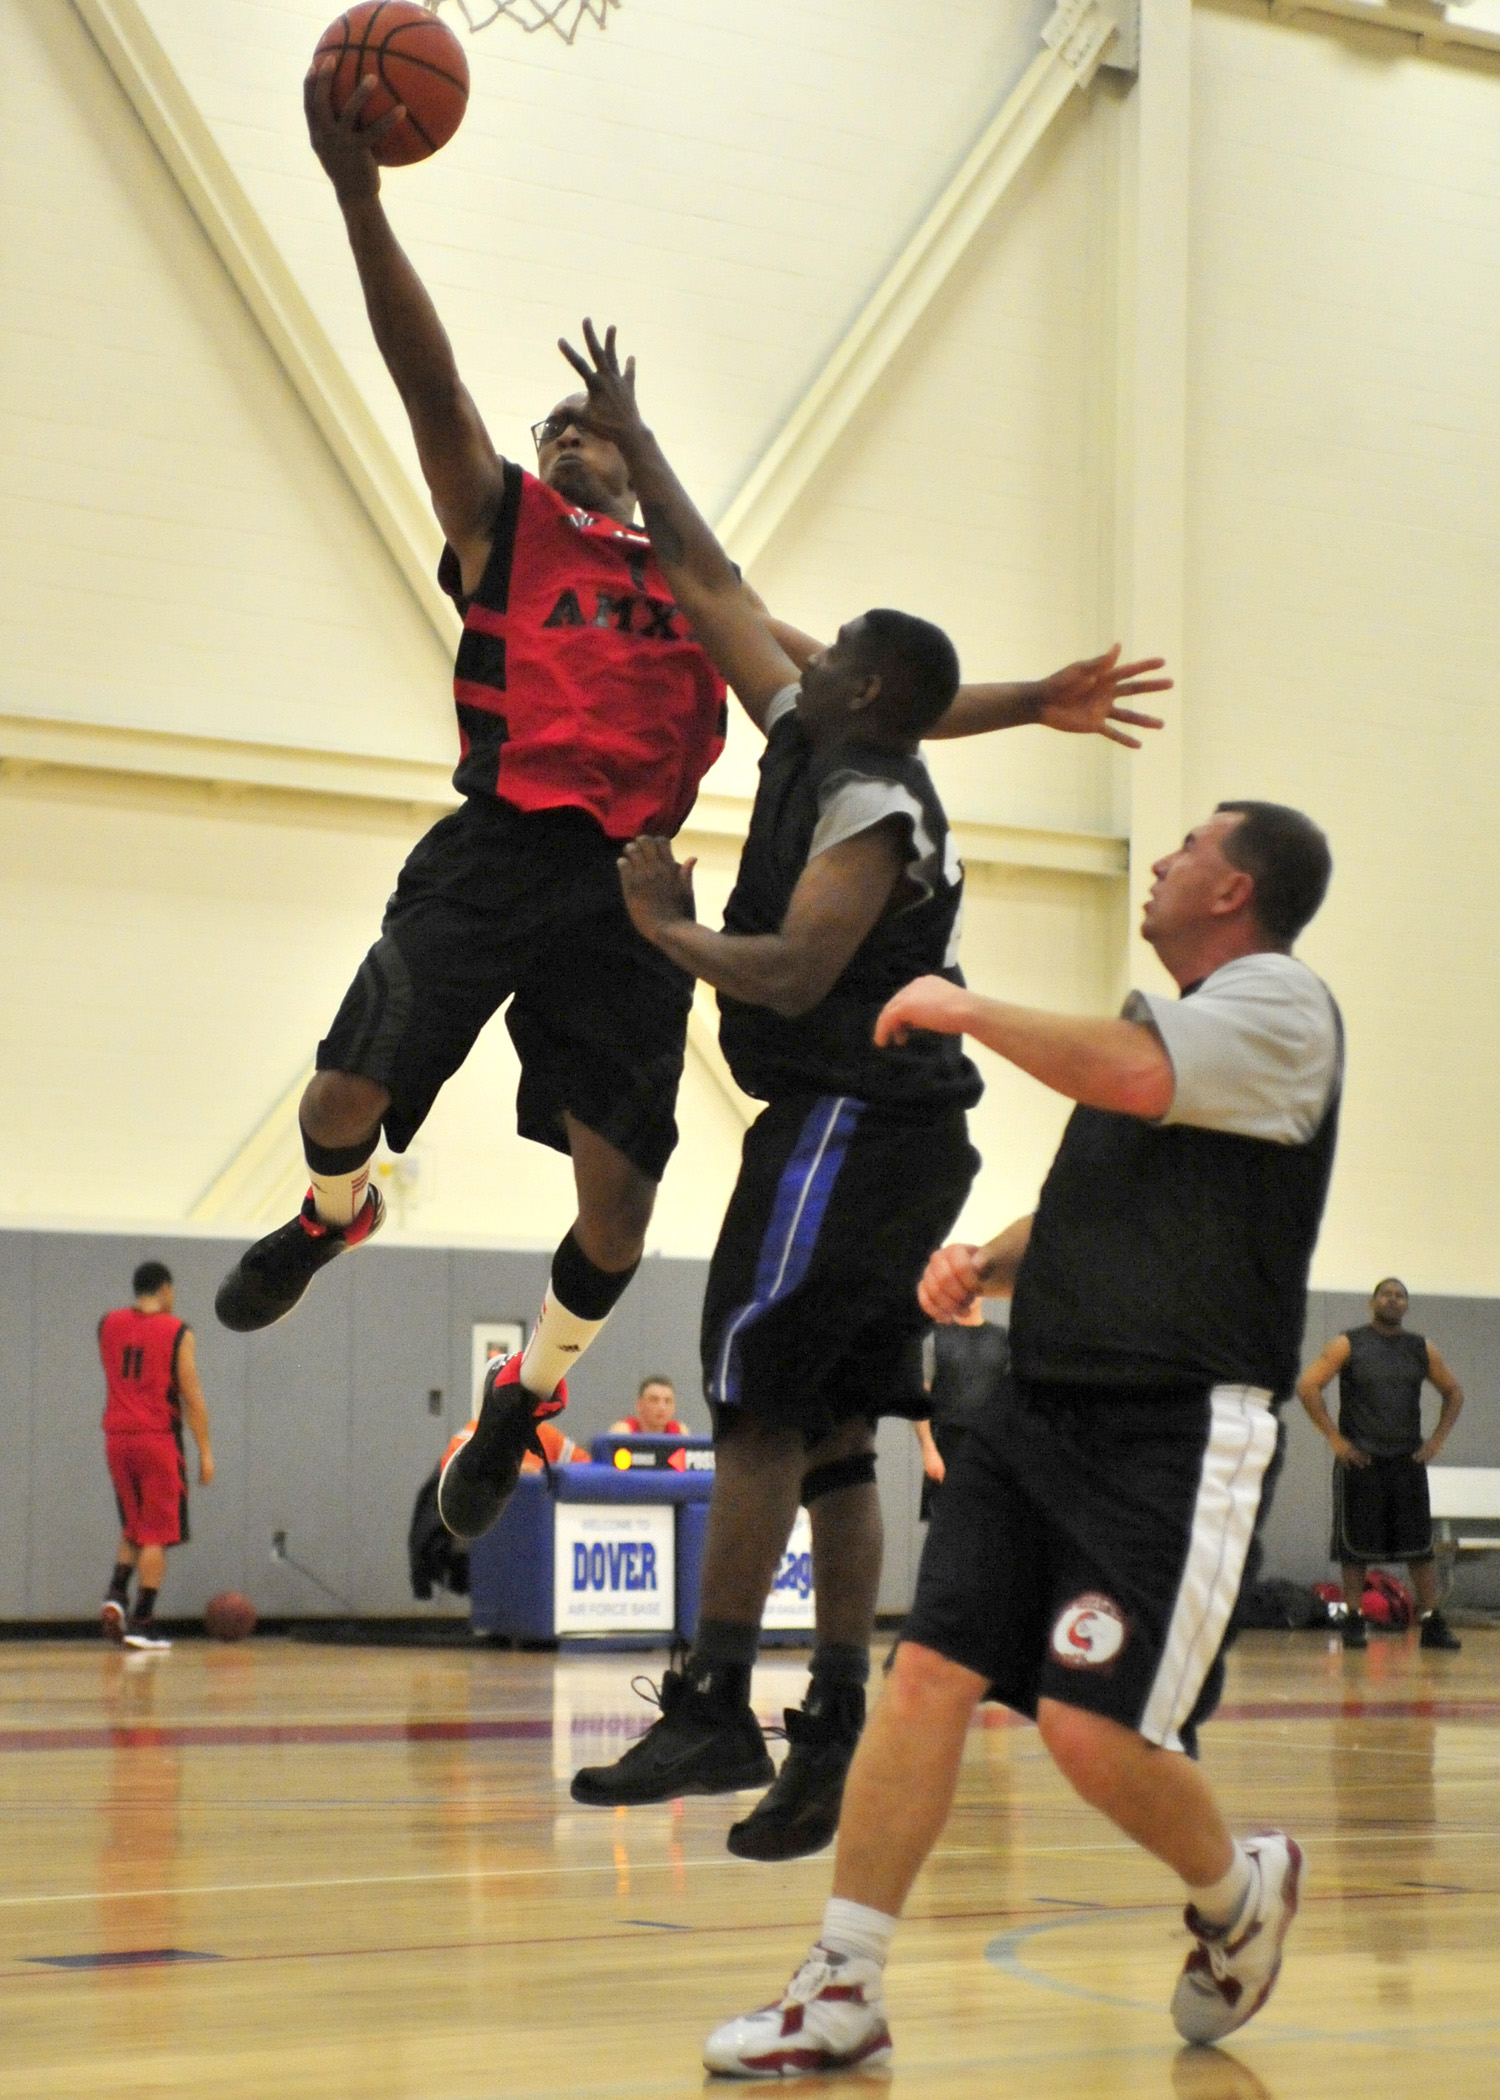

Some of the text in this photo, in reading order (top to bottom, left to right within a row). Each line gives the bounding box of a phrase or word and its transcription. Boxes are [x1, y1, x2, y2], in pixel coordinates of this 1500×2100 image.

[121, 1345, 144, 1380] 11
[573, 1542, 658, 1592] DOVER
[568, 1602, 660, 1616] AIR FORCE BASE
